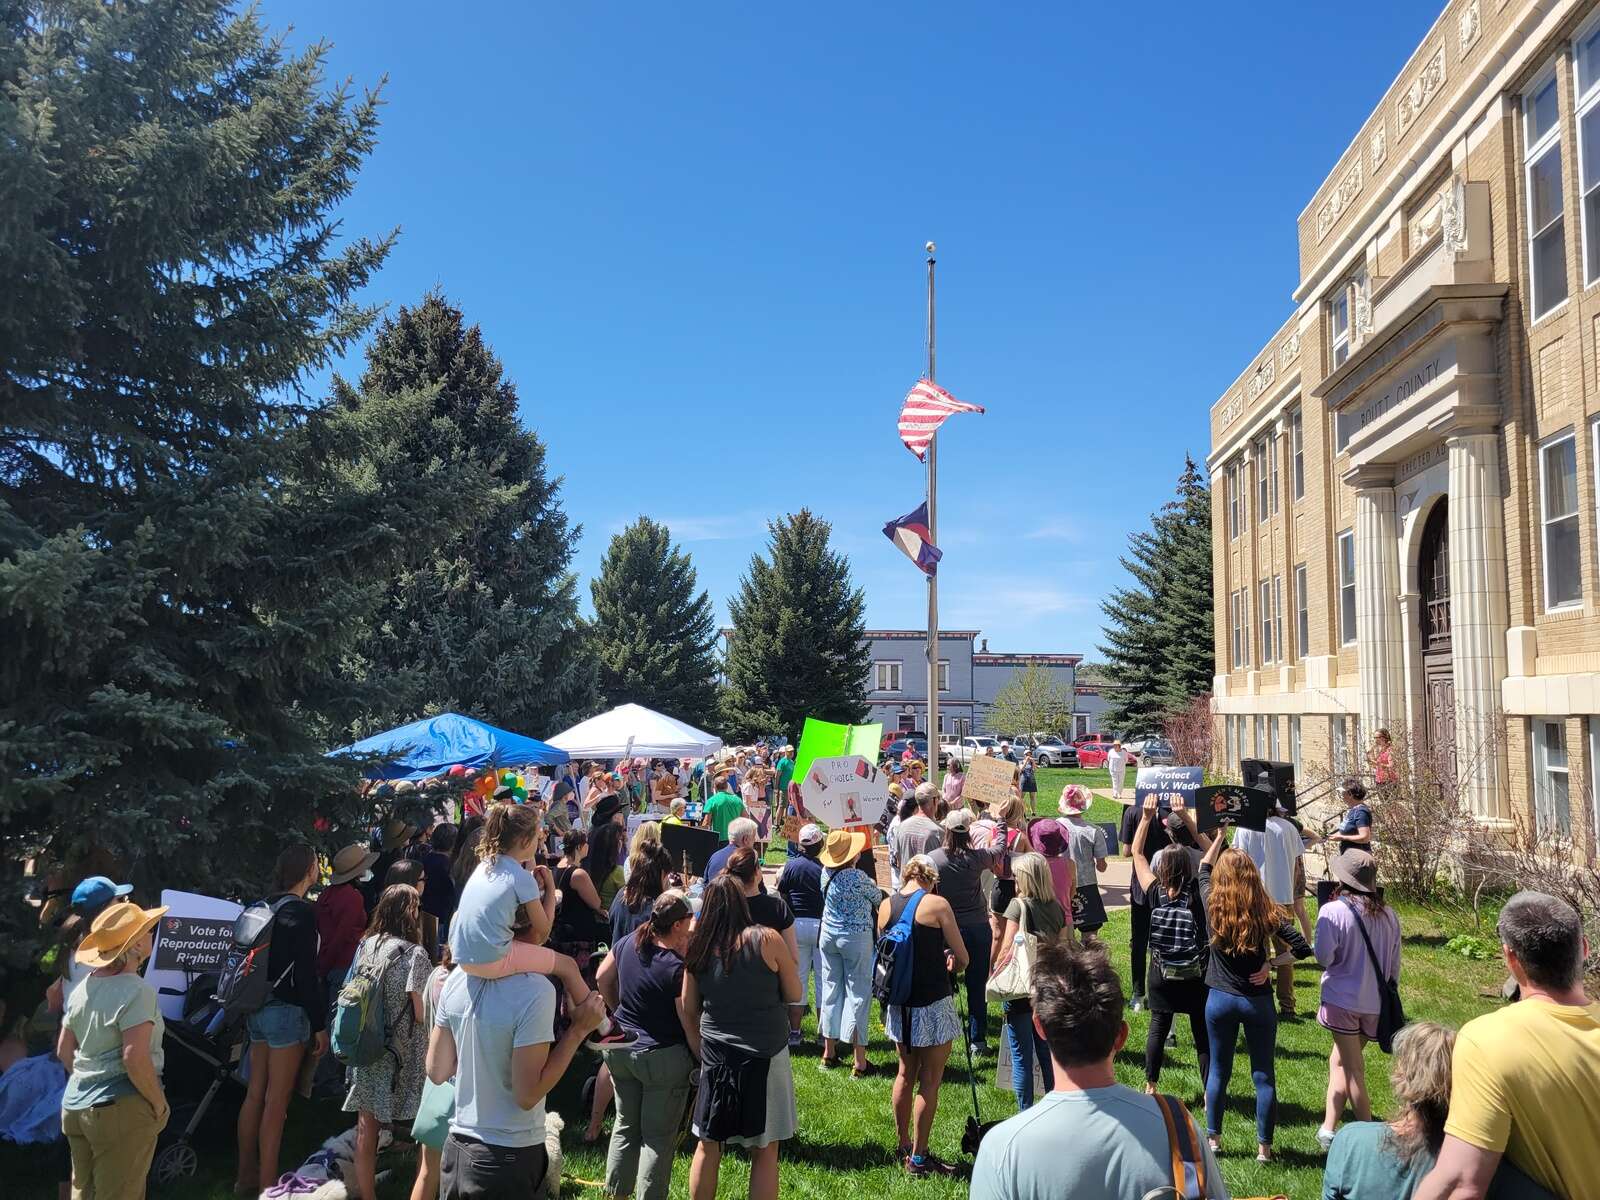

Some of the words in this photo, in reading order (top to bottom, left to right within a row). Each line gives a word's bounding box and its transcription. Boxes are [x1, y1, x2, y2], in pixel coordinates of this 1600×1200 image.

[1360, 394, 1390, 429] ROUTT
[1396, 359, 1439, 402] COUNTY
[832, 761, 848, 769] PRO
[830, 774, 855, 782] CHOICE
[1155, 771, 1191, 780] Protect
[1138, 781, 1158, 790] Roe
[1160, 781, 1169, 790] V.
[1172, 781, 1201, 790] Wade
[189, 925, 216, 936] Vote
[159, 937, 232, 951] Reproductiv
